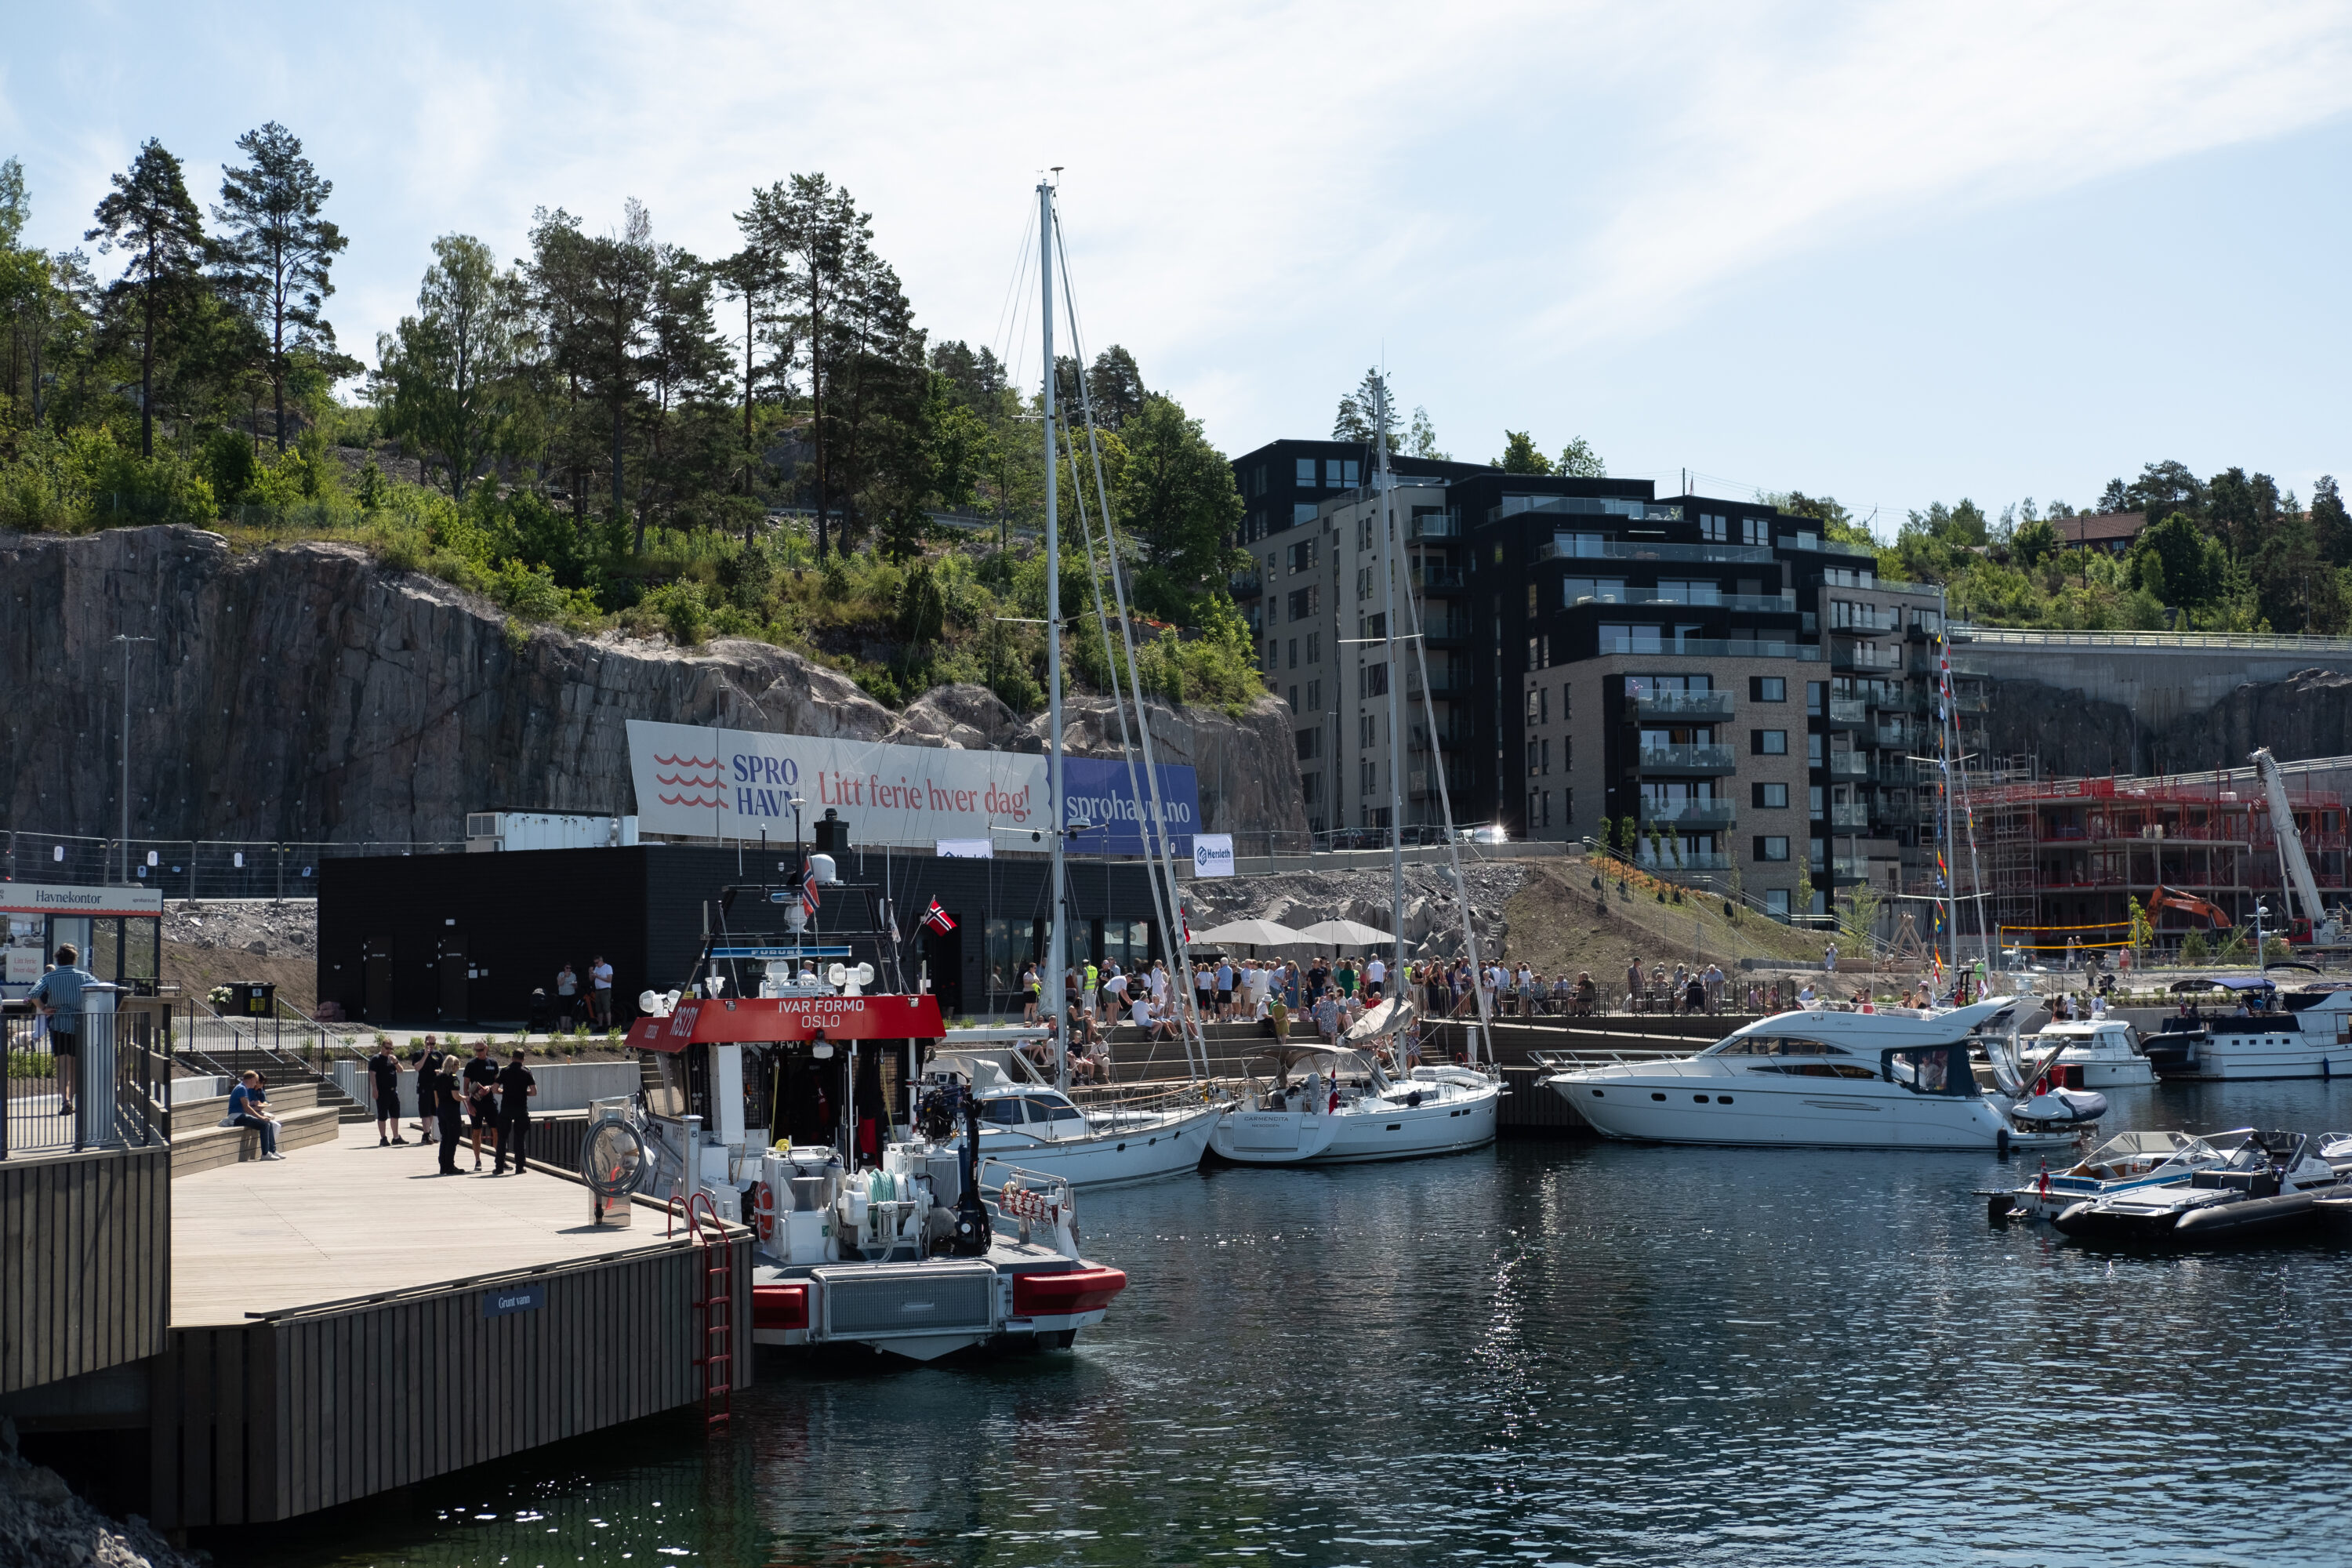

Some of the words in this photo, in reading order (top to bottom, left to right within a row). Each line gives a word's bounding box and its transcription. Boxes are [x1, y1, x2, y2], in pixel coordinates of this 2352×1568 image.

[732, 754, 798, 786] SPRO
[737, 786, 799, 818] HAVN
[818, 771, 863, 807] Litt
[869, 774, 923, 810] ferie
[927, 779, 977, 812] hver
[984, 782, 1032, 823] dag!
[1207, 848, 1231, 859] Hersleth
[36, 890, 102, 904] Havnekontor
[779, 1000, 811, 1013] IVAR
[815, 1000, 865, 1012] FORMO
[670, 1006, 699, 1038] RS171
[801, 1014, 840, 1029] OSLO
[499, 1297, 515, 1308] Grunt
[517, 1295, 530, 1305] vann
